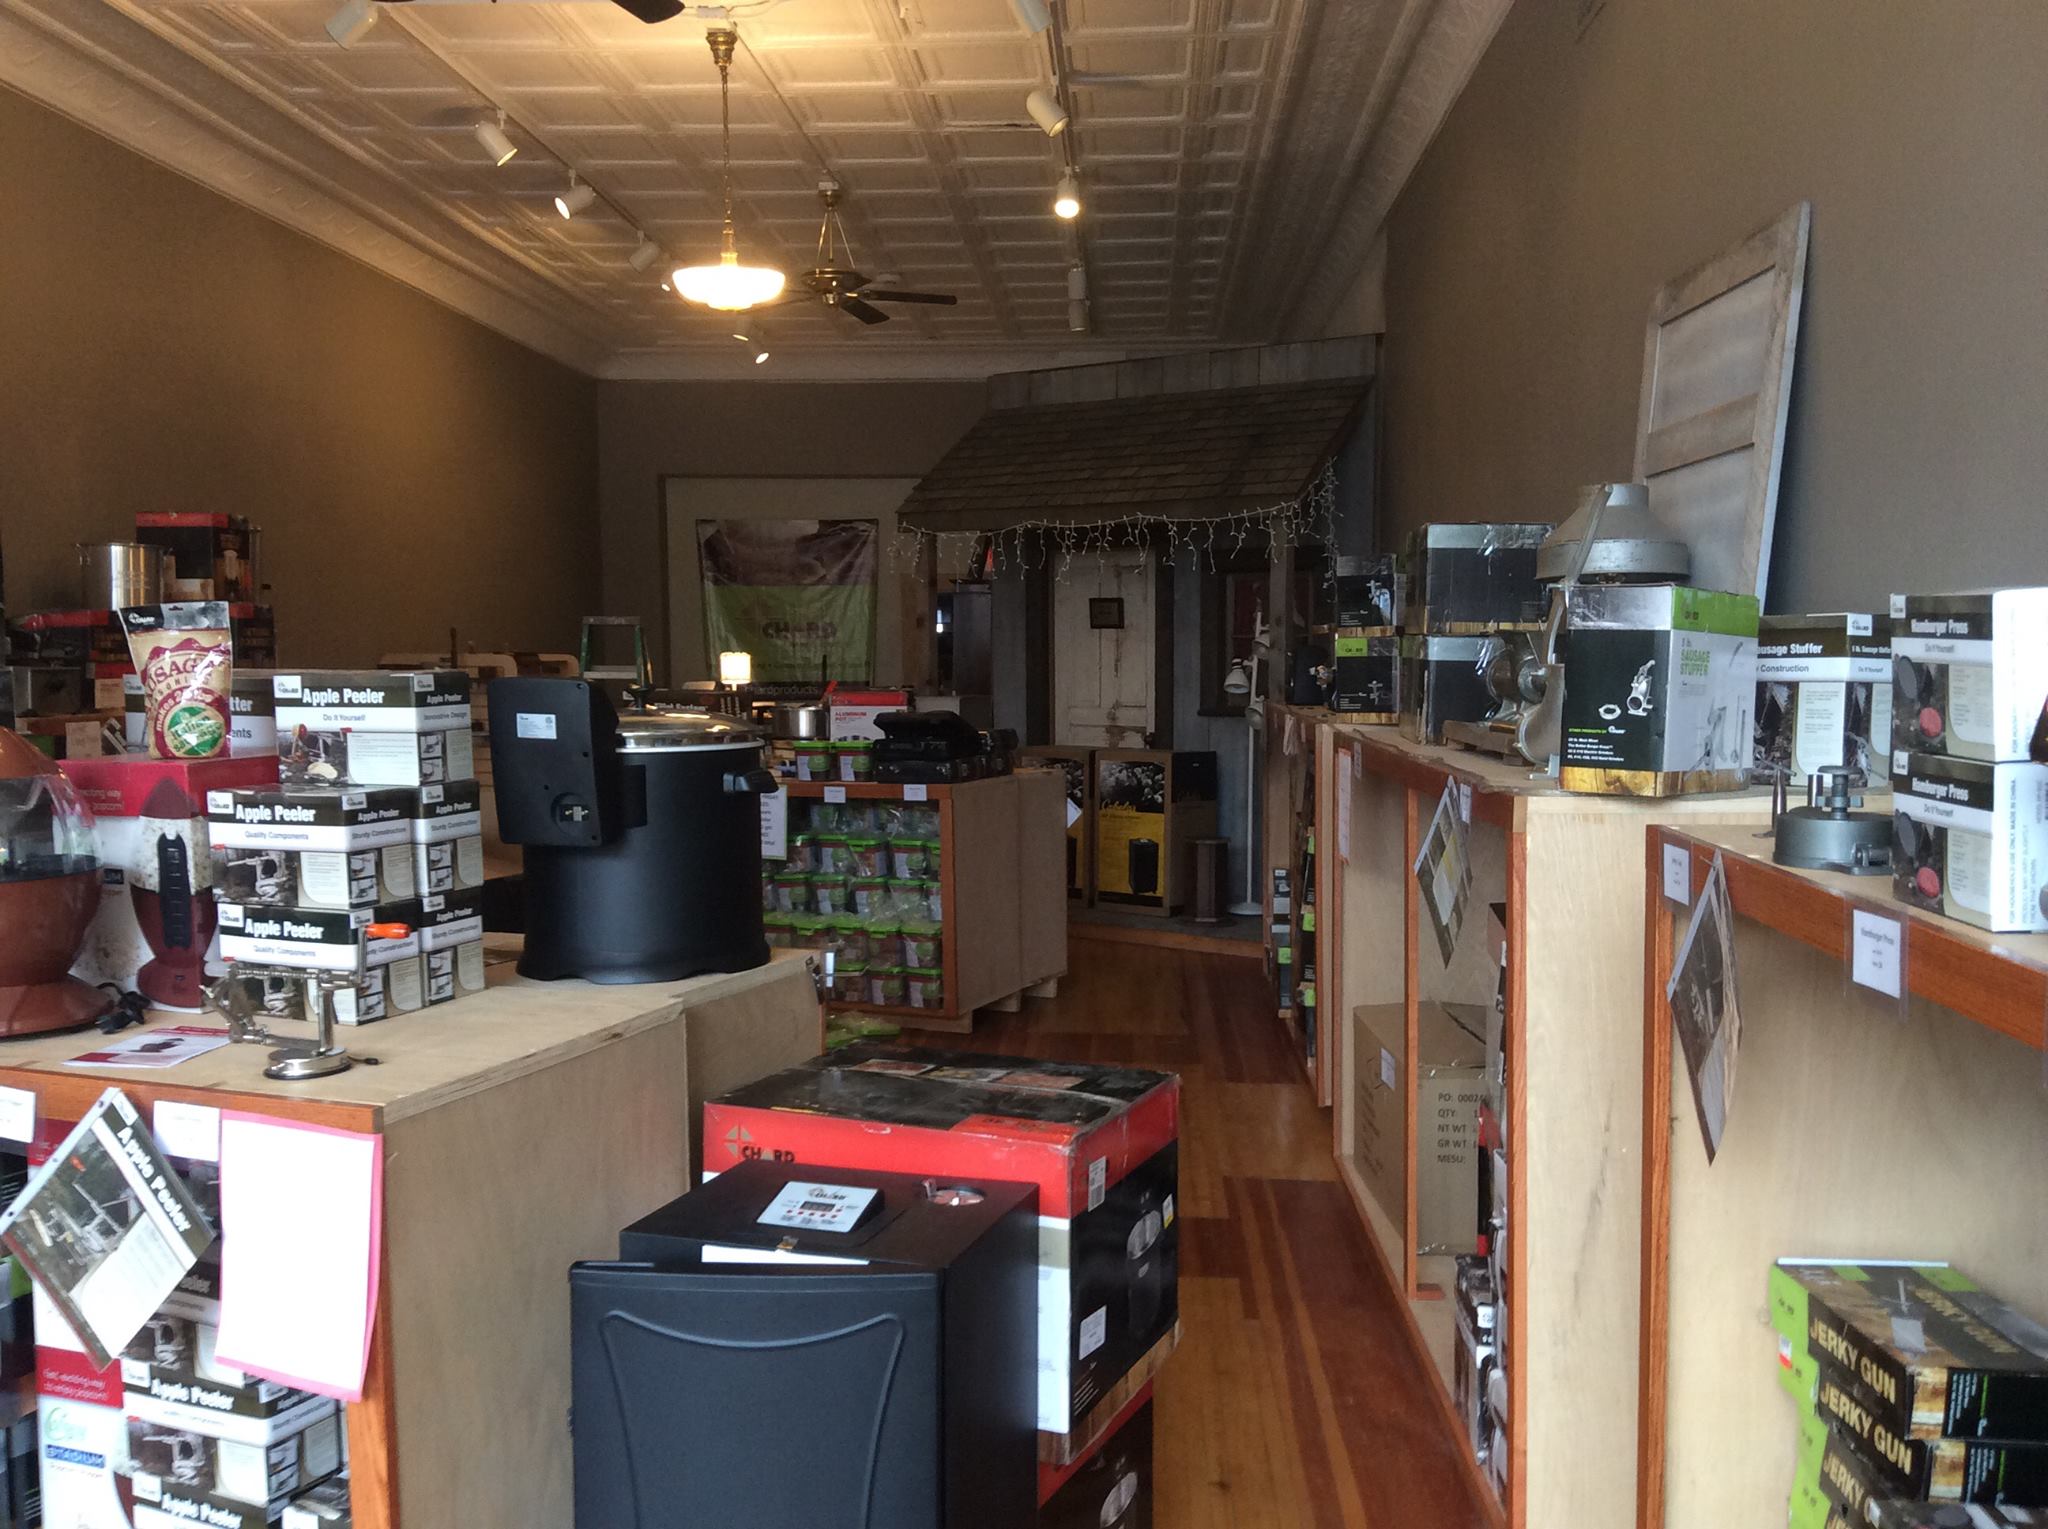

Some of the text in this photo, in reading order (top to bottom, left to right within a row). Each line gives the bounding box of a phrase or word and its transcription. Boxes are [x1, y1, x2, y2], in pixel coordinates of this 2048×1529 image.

[1949, 619, 1969, 634] Press
[1790, 643, 1823, 654] Stuffer
[1760, 664, 1809, 673] Construction
[302, 688, 385, 706] Apple Peeler
[427, 693, 463, 703] Apple Peeler
[236, 804, 316, 822] Apple Peeler
[358, 808, 399, 821] Apple Peeler
[448, 819, 478, 829] Construction
[245, 831, 309, 841] Quality Components
[372, 826, 407, 837] Construction
[245, 918, 324, 940] Apple Peeler
[277, 945, 316, 957] Components
[1438, 1124, 1466, 1133] NT WT
[1438, 1139, 1466, 1149] GR WT
[117, 1126, 155, 1179] Apple
[151, 1175, 192, 1233] Peeler
[1810, 1317, 1858, 1372] JERKY
[1860, 1355, 1897, 1406] GUN
[151, 1378, 235, 1411] Apple Peeler
[1821, 1382, 1913, 1476] JERKY GUN
[1823, 1451, 1866, 1511] JERKY
[162, 1492, 243, 1529] Apple Peeler
